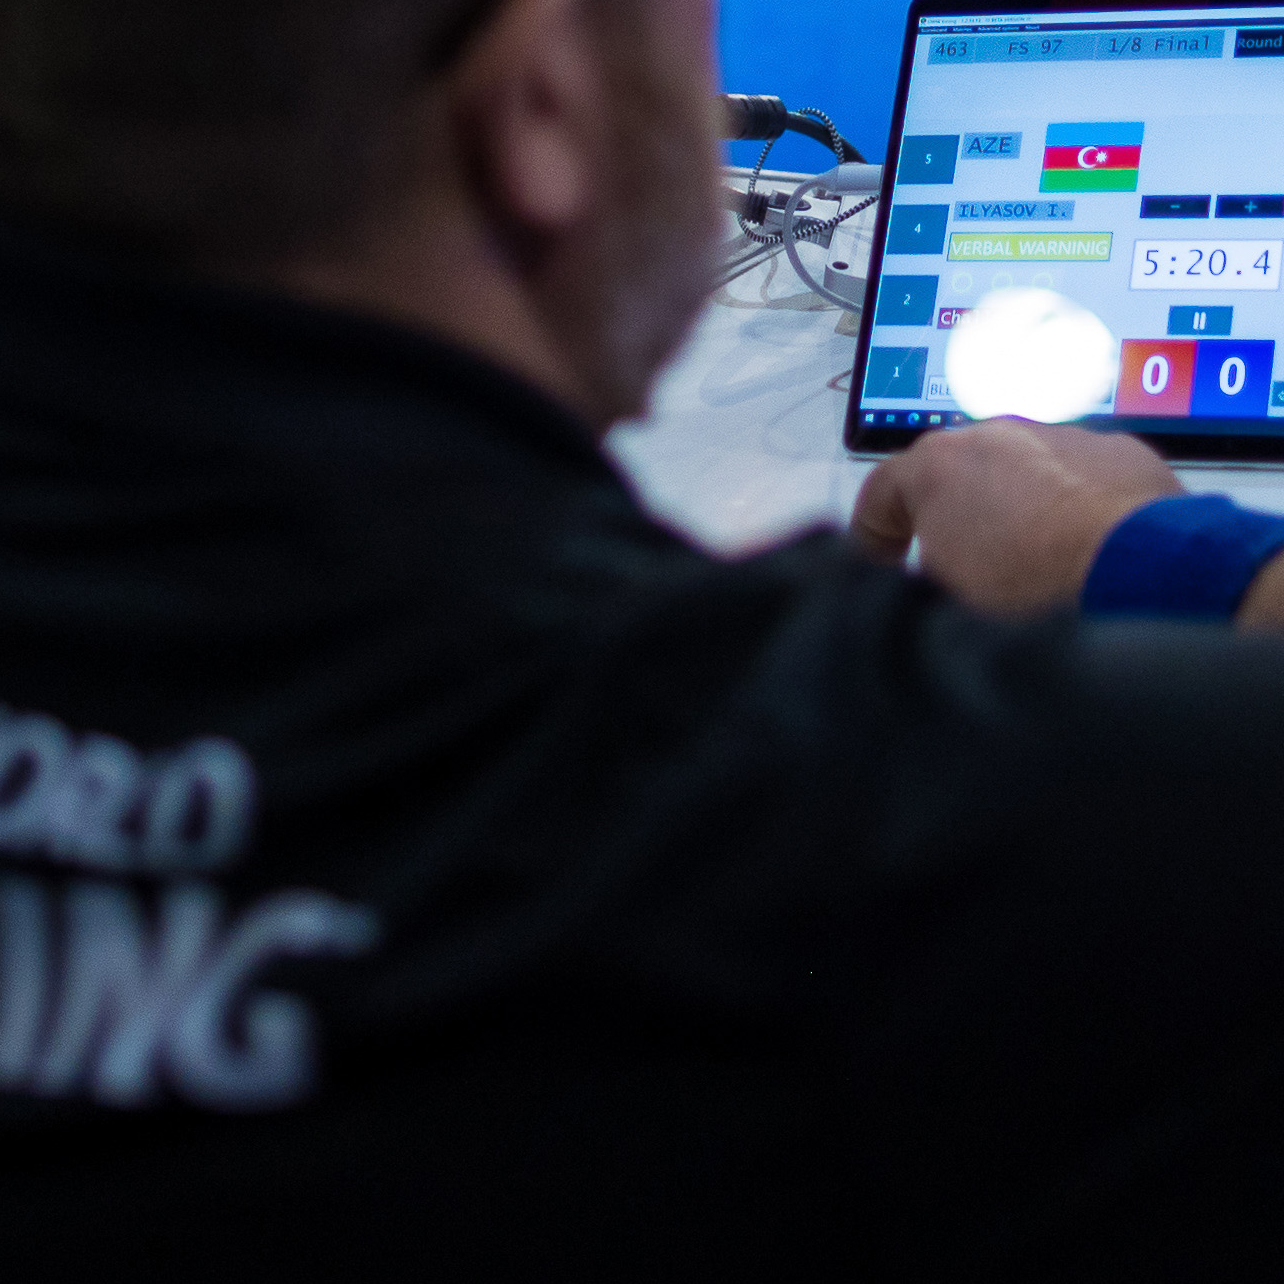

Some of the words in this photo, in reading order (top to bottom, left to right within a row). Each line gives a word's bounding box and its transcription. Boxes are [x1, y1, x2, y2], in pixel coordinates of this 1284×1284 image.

[934, 42, 968, 58] 463
[1007, 40, 1030, 56] FS
[1041, 39, 1064, 55] 97
[1107, 36, 1142, 55] 1/8
[1153, 35, 1211, 52] Final
[1236, 35, 1283, 49] Round
[967, 136, 1014, 154] AZE
[924, 153, 933, 165] 5
[959, 203, 1037, 217] ILYASOV
[1047, 203, 1067, 217] I.
[914, 223, 922, 234] 4
[952, 240, 1013, 255] VERBAL
[1018, 239, 1109, 255] WARNINIG
[1143, 249, 1271, 276] 5:20.4
[903, 293, 911, 305] 2
[893, 366, 900, 378] 1
[1141, 354, 1170, 396] 0
[1219, 356, 1246, 396] 0
